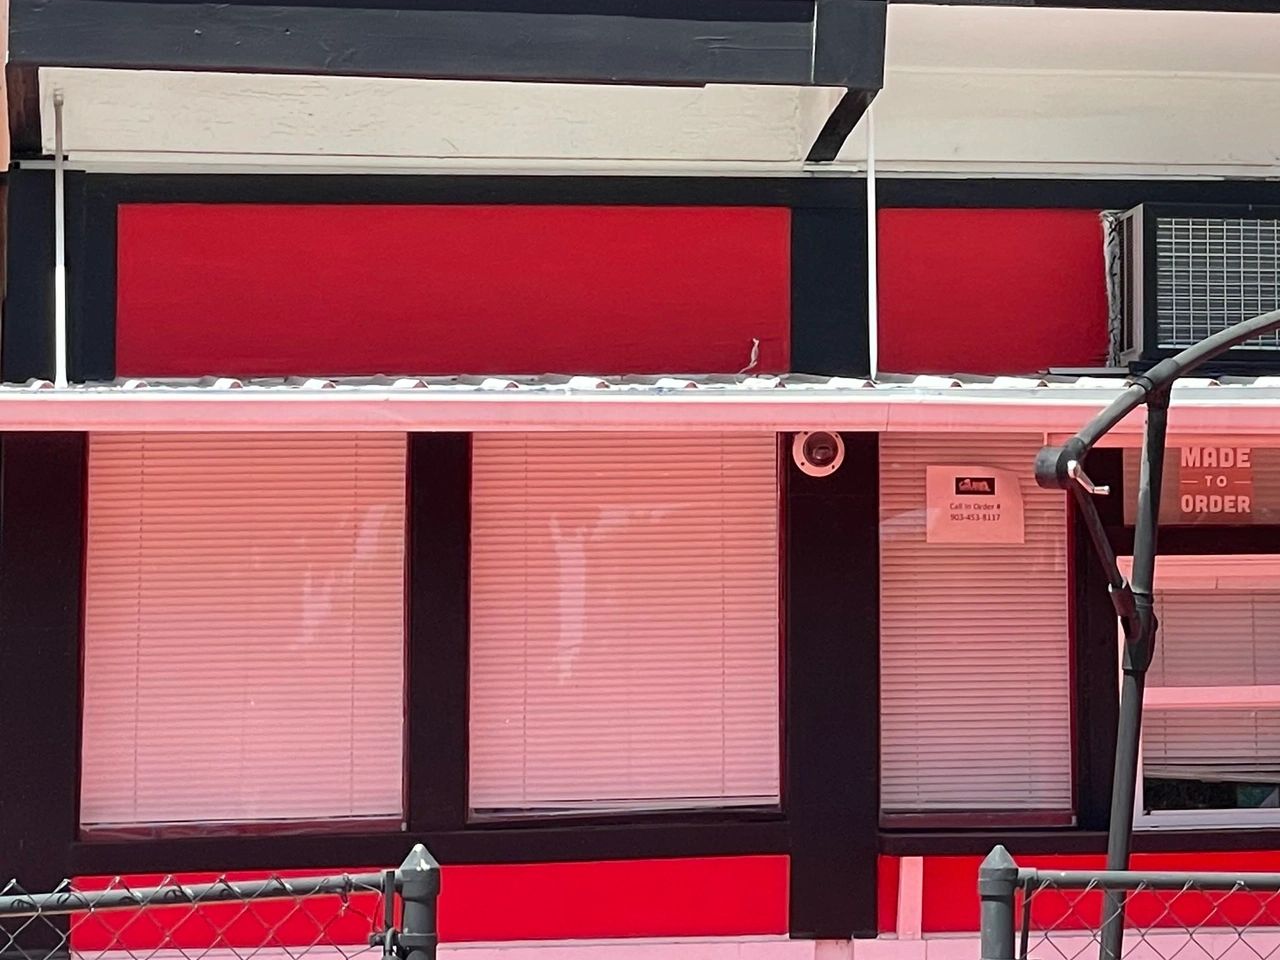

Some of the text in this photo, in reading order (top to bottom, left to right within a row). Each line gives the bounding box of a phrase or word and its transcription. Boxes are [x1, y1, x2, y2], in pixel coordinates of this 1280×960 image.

[1181, 446, 1251, 468] MADE
[1205, 475, 1228, 488] TO
[949, 502, 963, 510] Call
[973, 502, 995, 510] Order
[1181, 494, 1251, 513] ORDER
